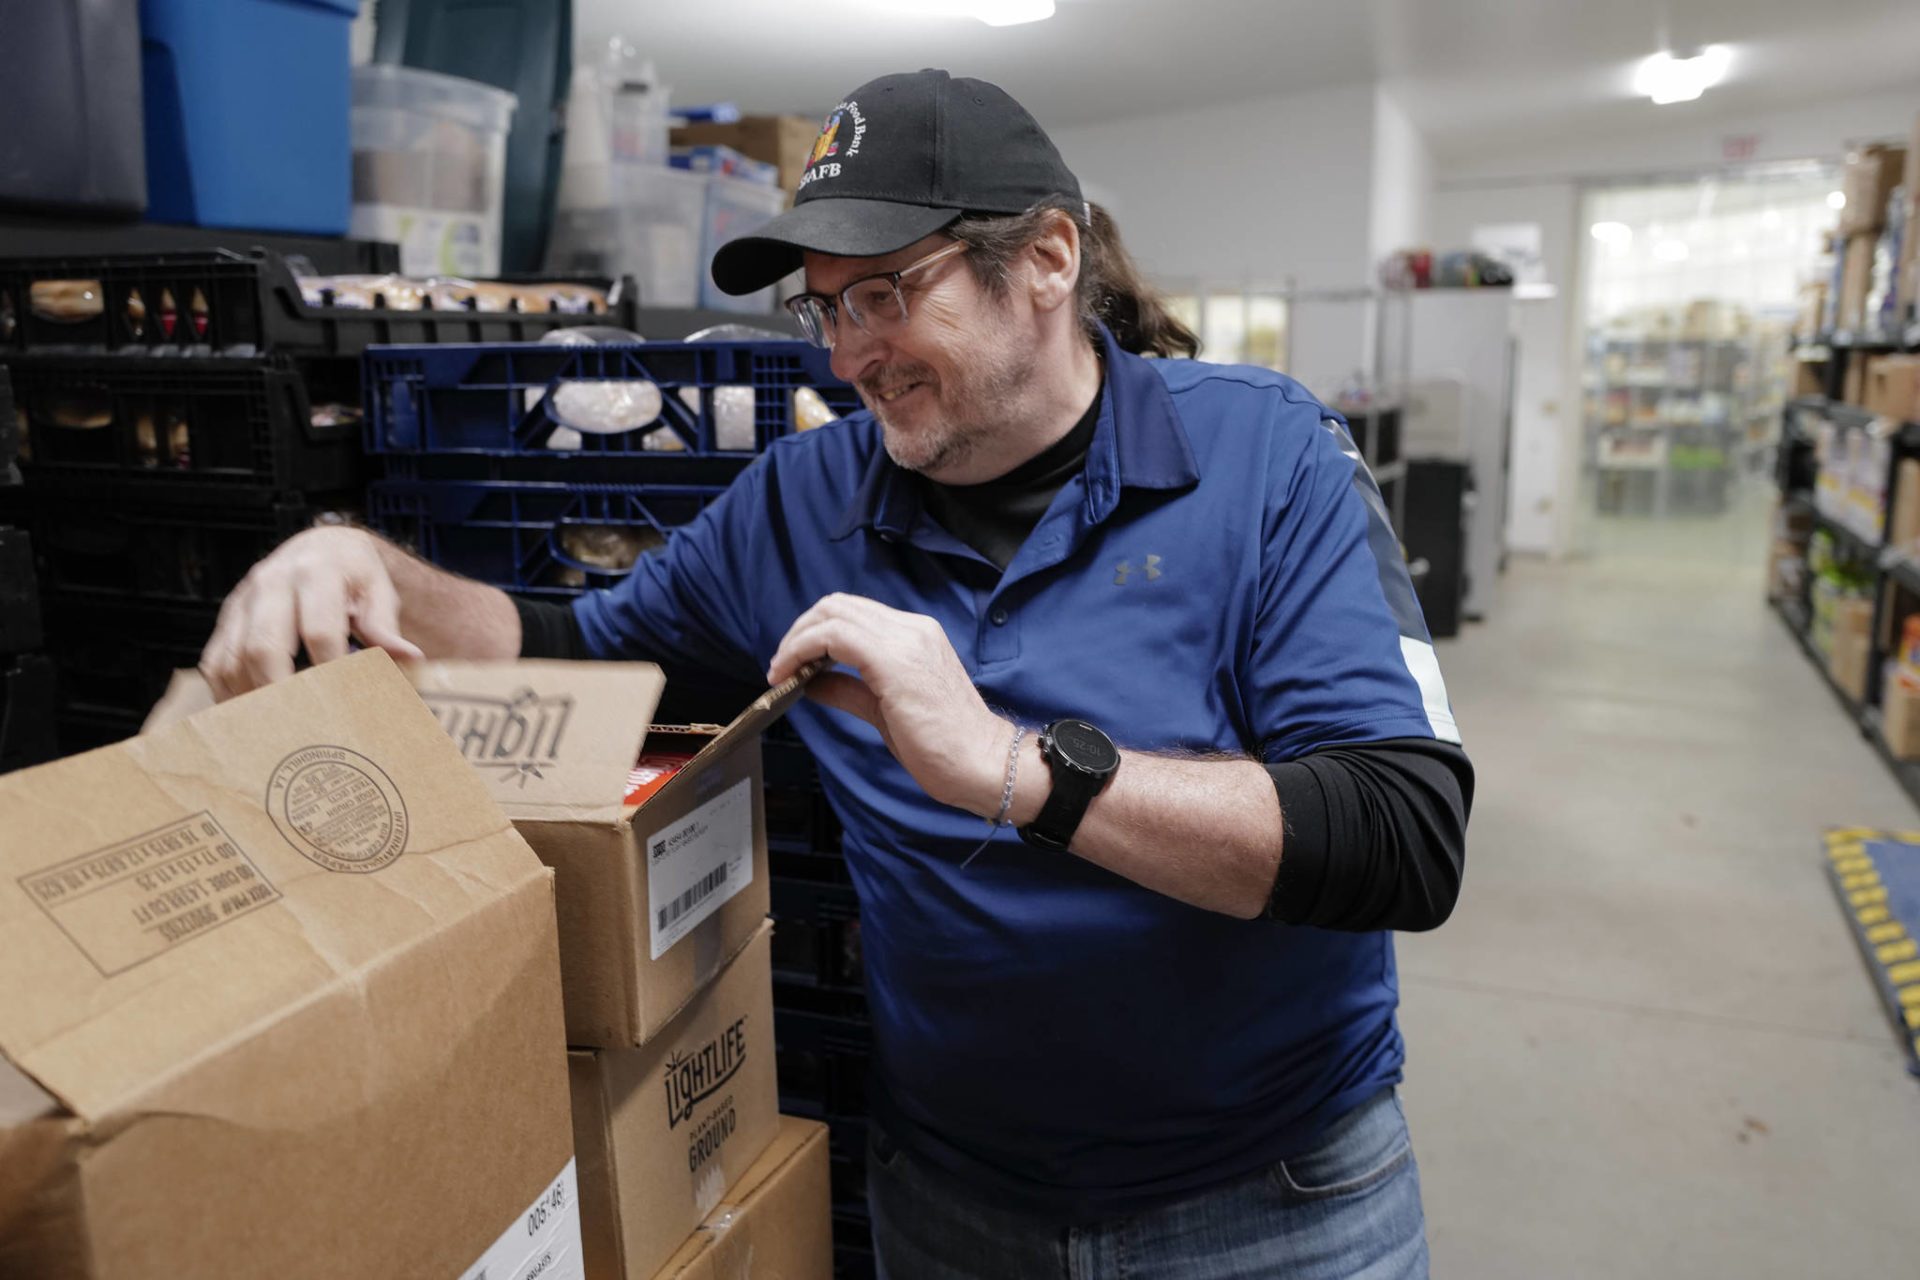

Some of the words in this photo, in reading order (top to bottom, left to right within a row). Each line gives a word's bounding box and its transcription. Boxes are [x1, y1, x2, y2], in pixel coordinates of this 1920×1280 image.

[845, 125, 867, 158] Bank
[273, 774, 287, 790] LA
[350, 779, 370, 794] TEST
[357, 787, 377, 802] EDGE
[326, 799, 356, 818] CRUSH
[201, 821, 220, 837] ID
[353, 811, 404, 870] INTERNATIONAL
[201, 849, 219, 866] 17
[215, 842, 237, 860] OD
[312, 851, 351, 871] PAPER
[688, 1108, 737, 1174] GROUND
